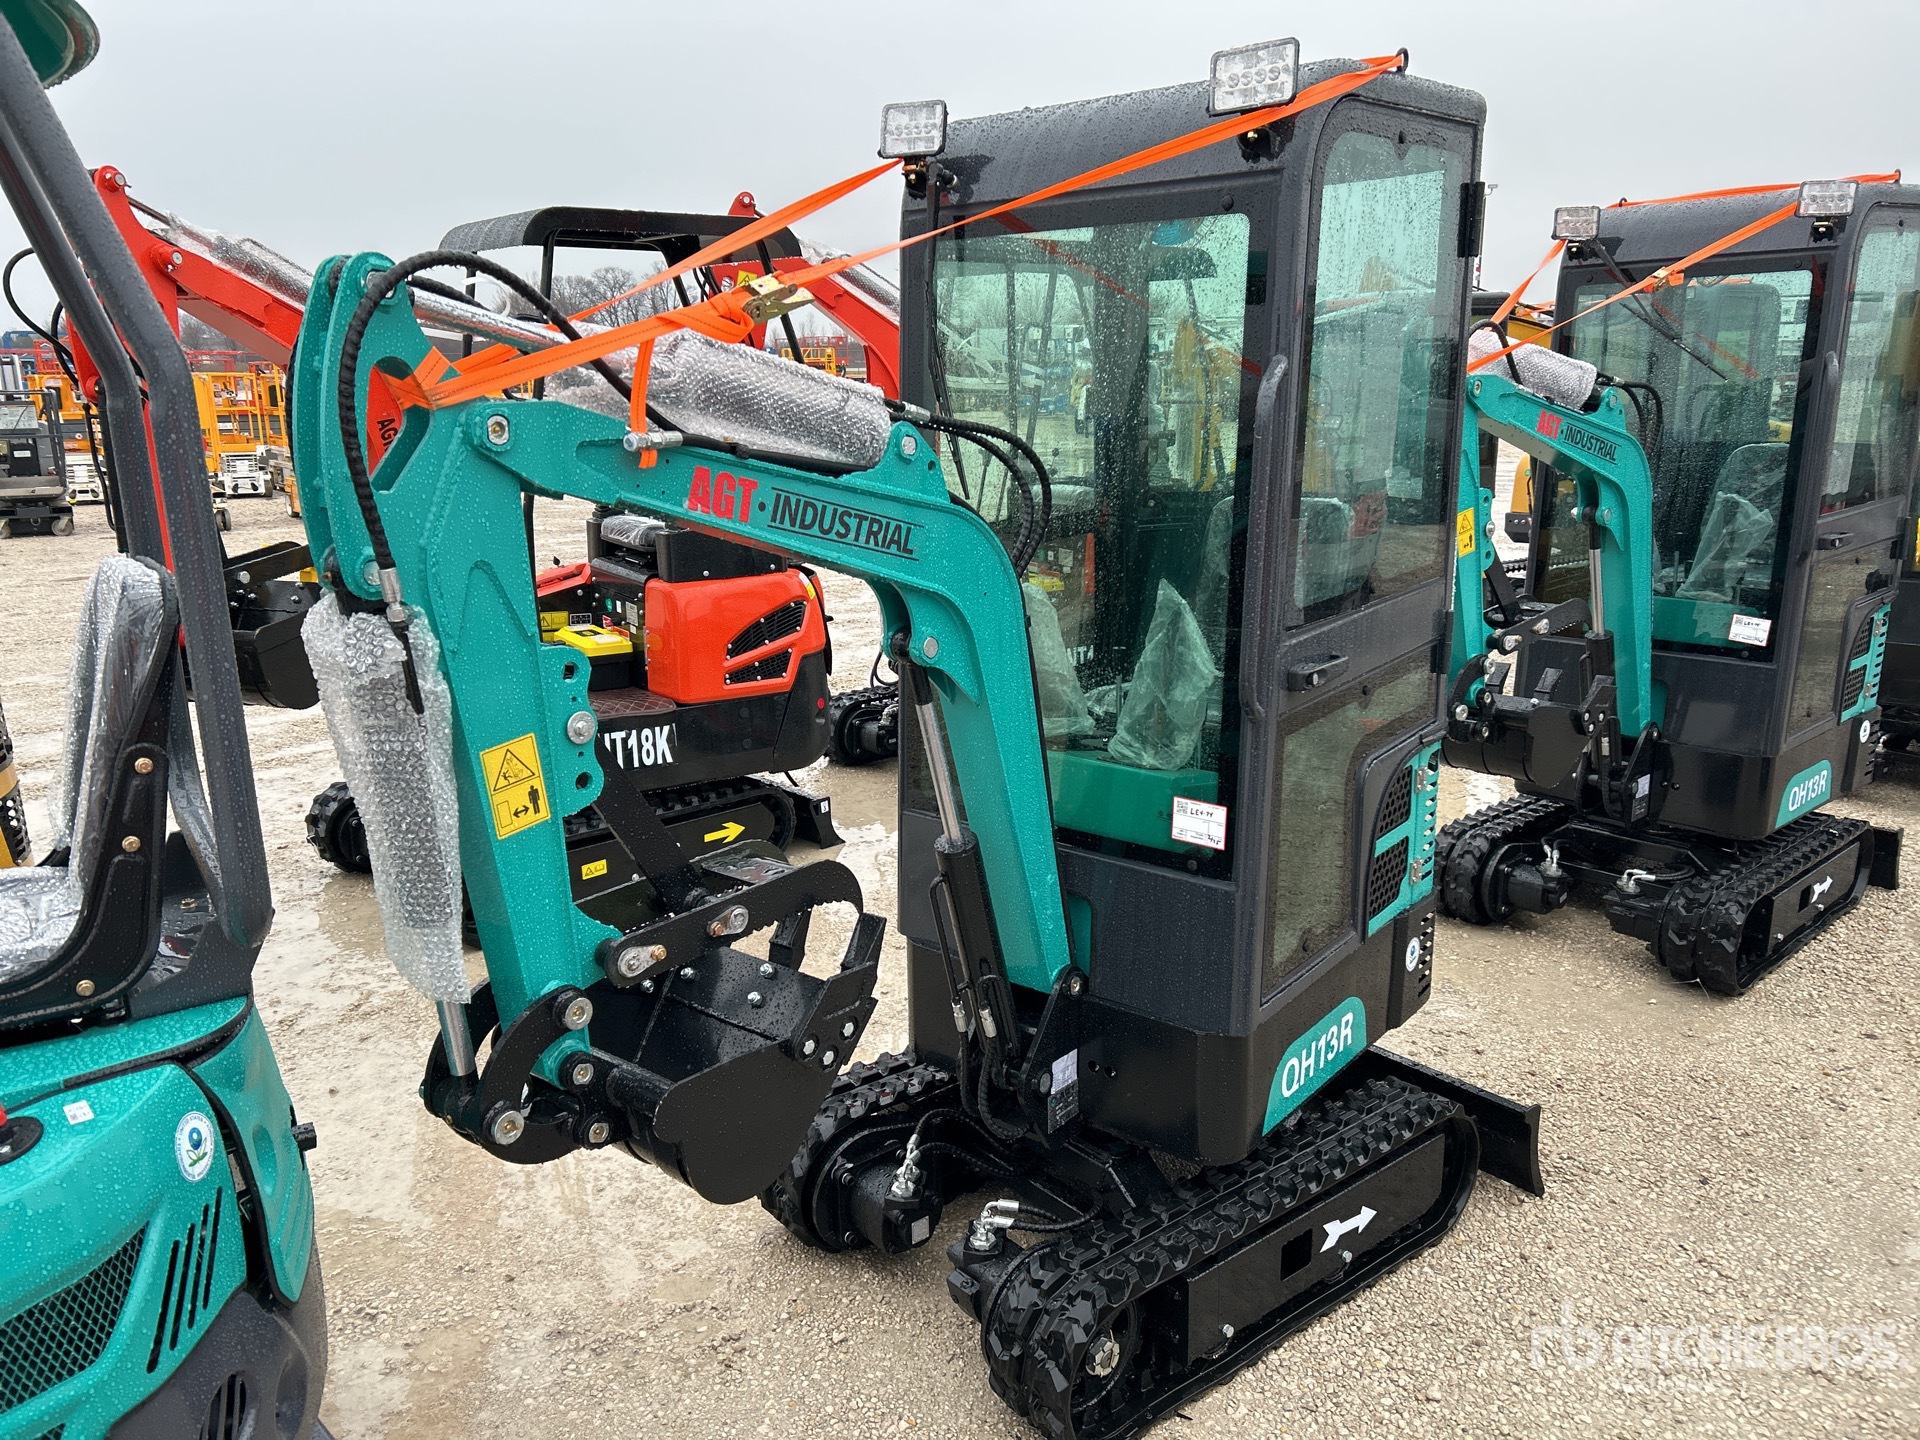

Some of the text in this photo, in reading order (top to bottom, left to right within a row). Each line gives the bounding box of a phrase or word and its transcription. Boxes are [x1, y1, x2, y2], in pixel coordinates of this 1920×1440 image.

[1536, 409, 1618, 462] AGT INDUSTRIAL
[687, 465, 915, 555] AGT INDUSTRIAL
[1788, 769, 1828, 812] QH13R
[1281, 1011, 1354, 1098] QH13R
